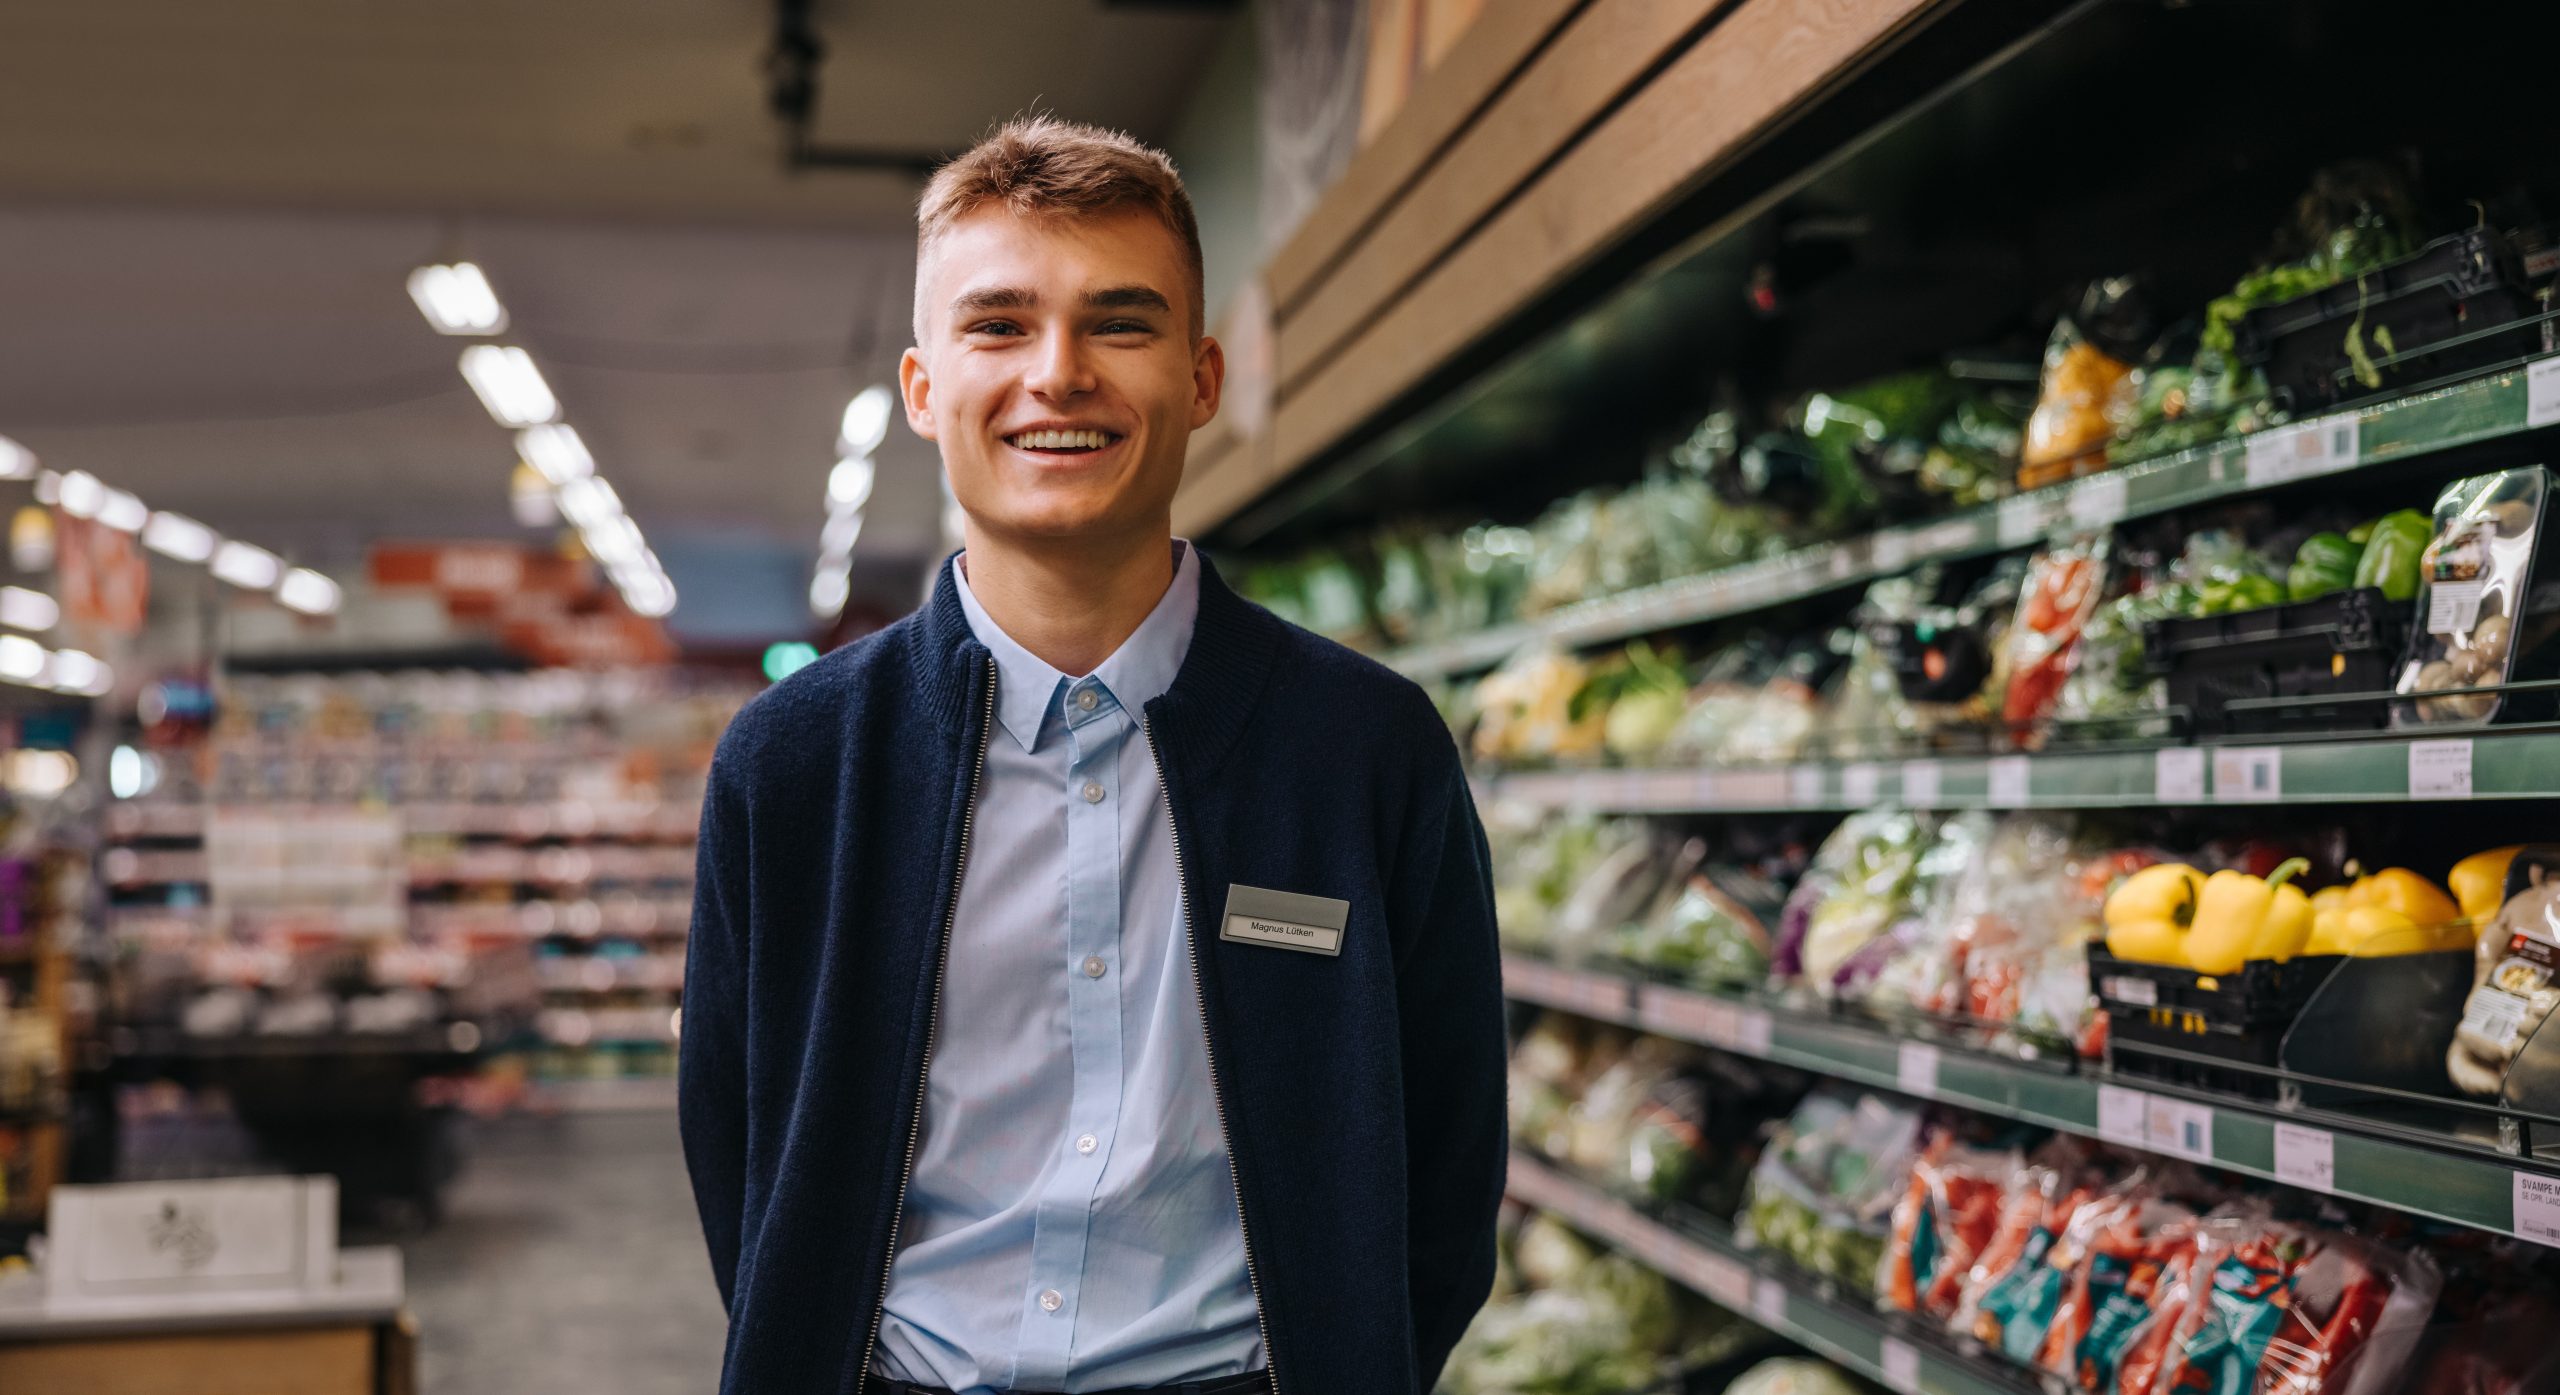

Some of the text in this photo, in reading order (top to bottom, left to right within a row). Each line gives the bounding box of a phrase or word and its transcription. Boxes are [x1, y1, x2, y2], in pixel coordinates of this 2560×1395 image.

[1251, 921, 1314, 937] Magnus Lütken
[2522, 1179, 2552, 1194] SVAMPE
